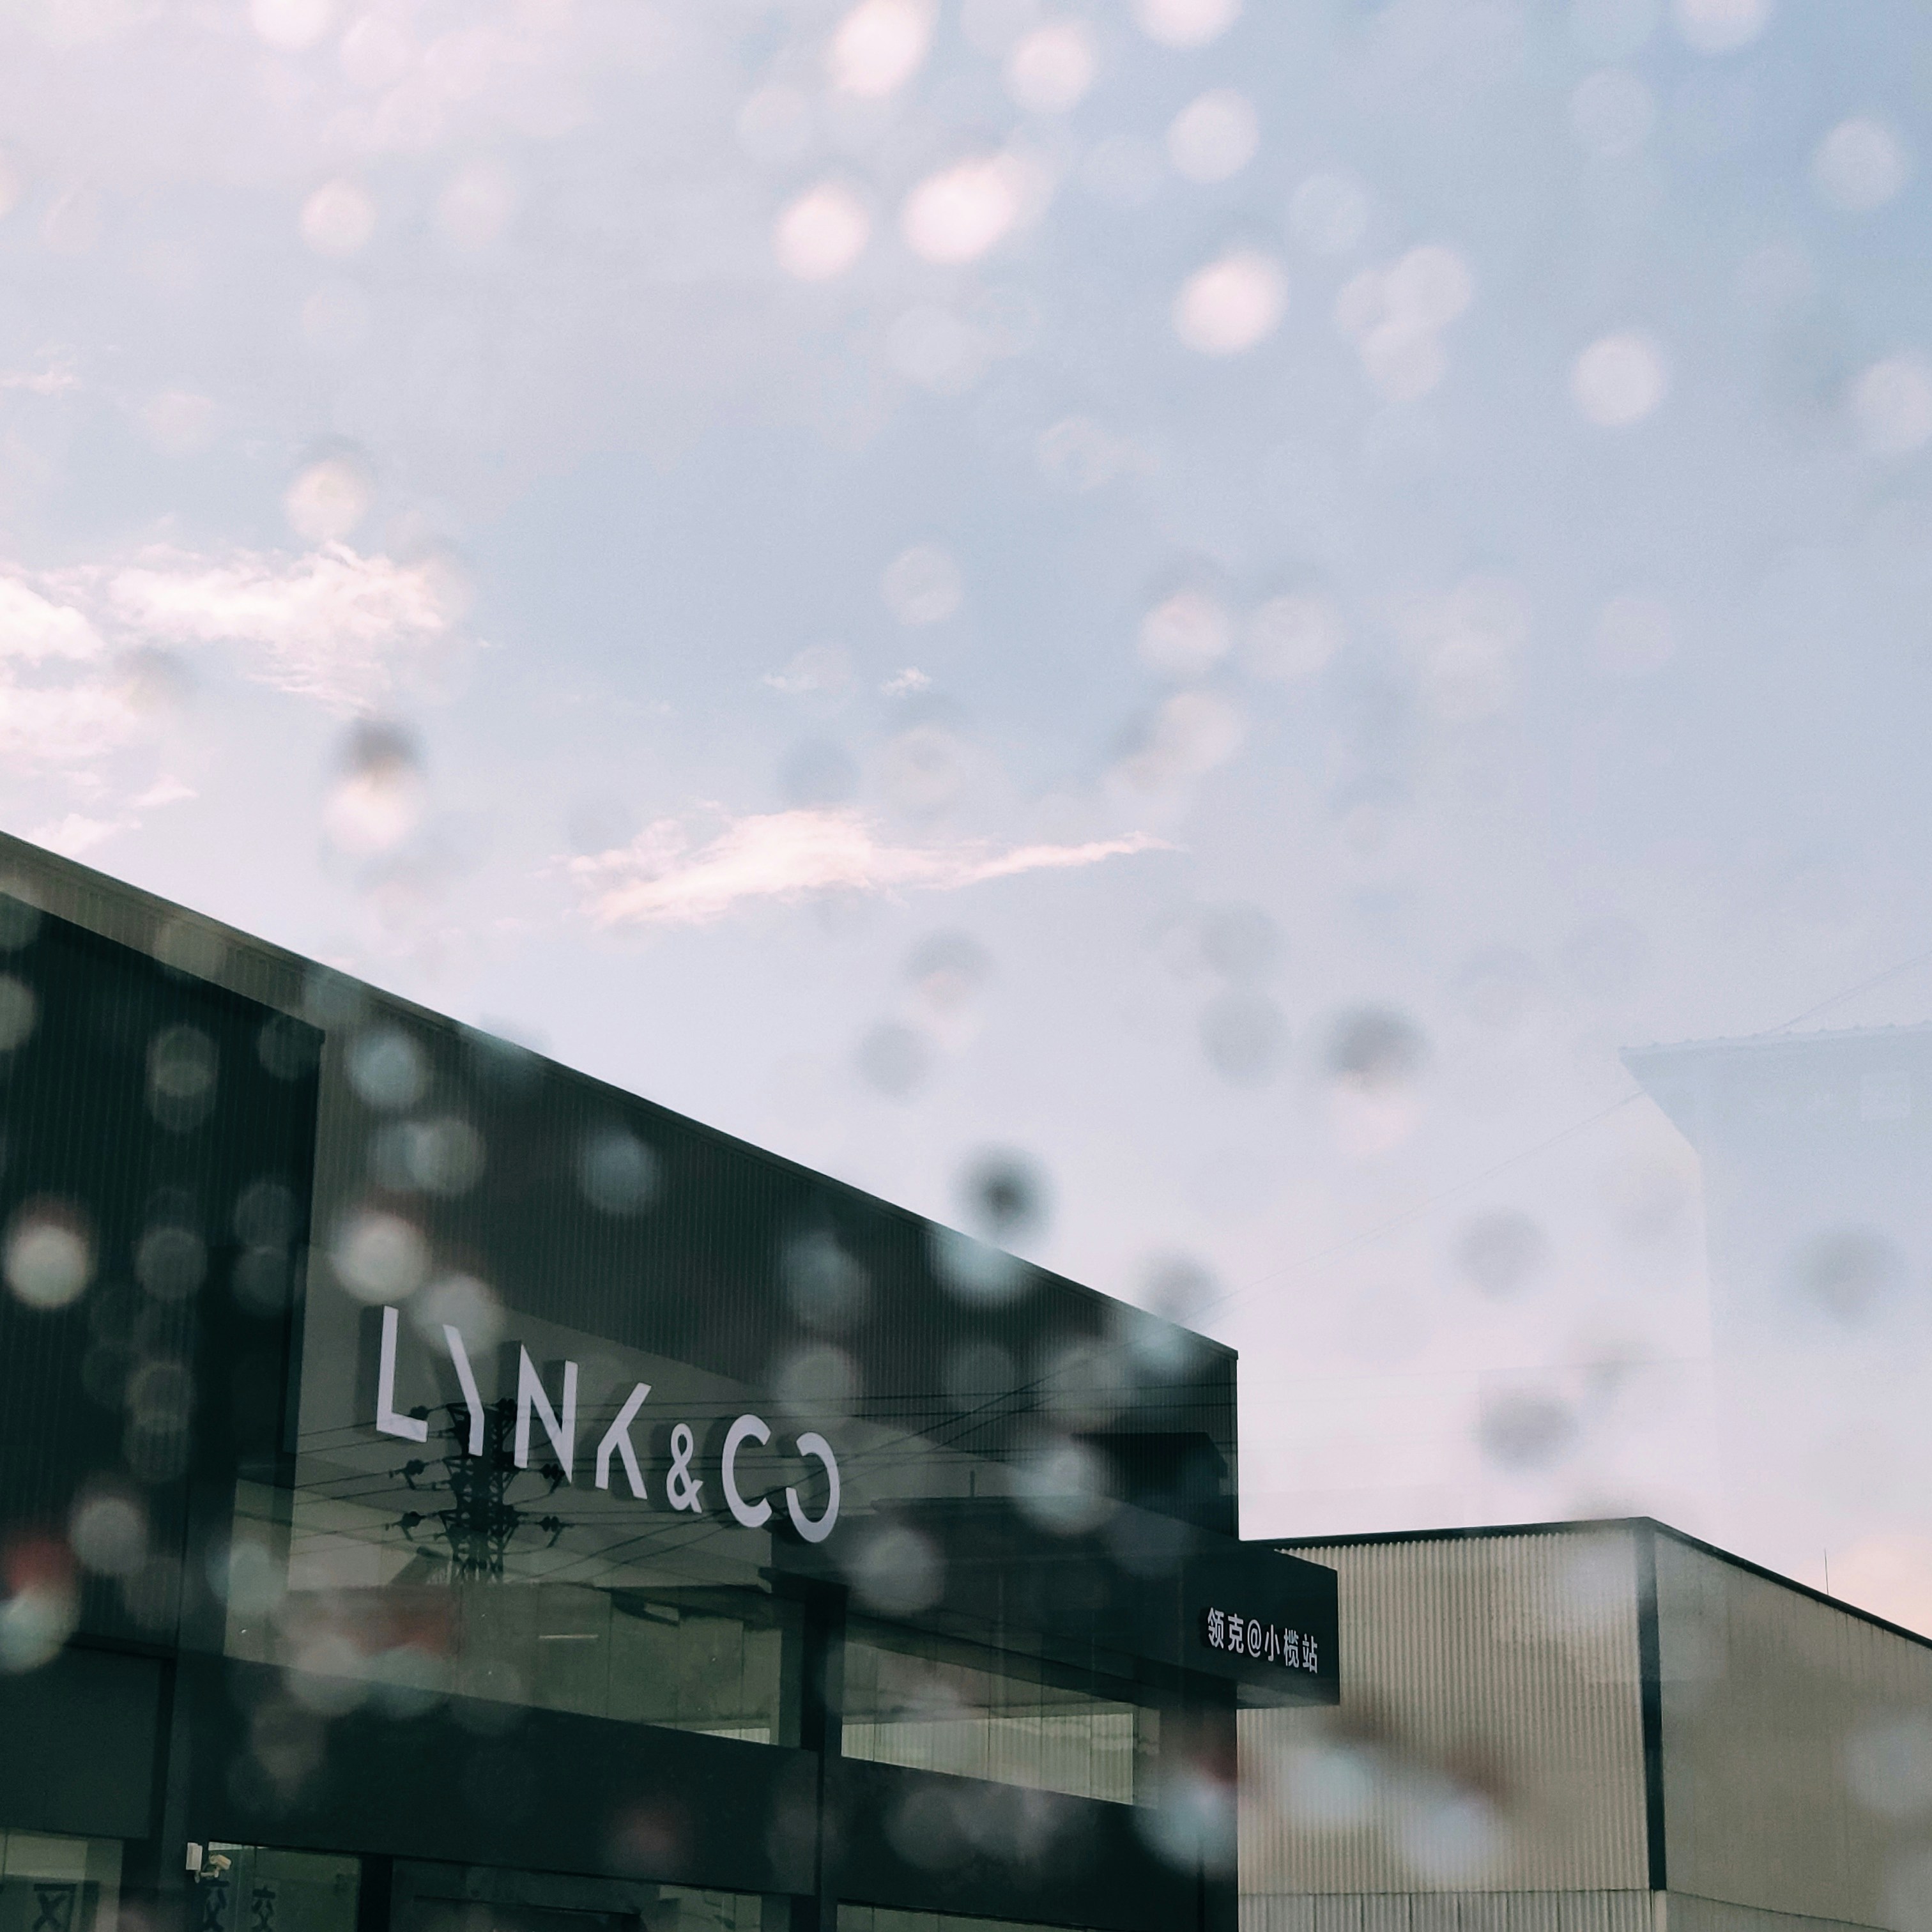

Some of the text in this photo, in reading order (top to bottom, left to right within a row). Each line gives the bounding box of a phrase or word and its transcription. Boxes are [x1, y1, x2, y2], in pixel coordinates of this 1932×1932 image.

[1208, 1607, 1318, 1675] 领克@小榄站
